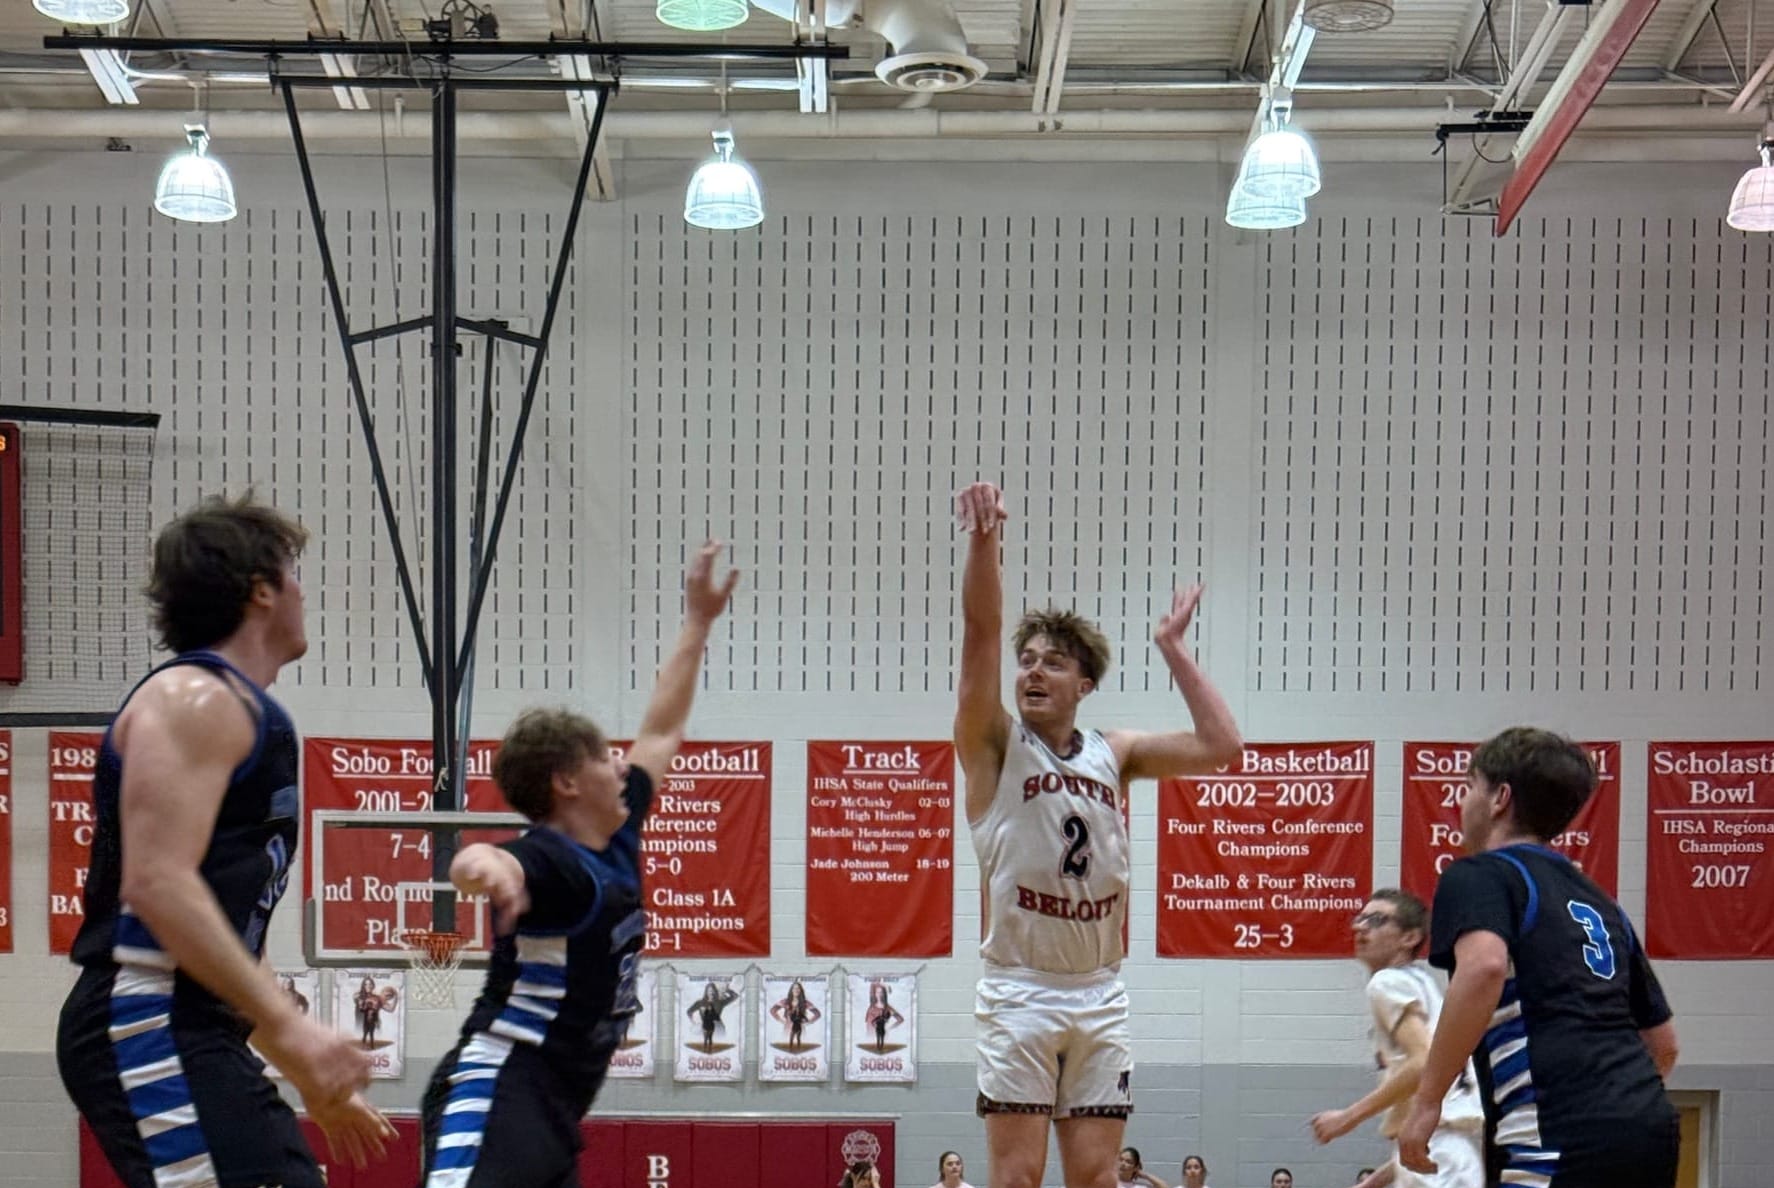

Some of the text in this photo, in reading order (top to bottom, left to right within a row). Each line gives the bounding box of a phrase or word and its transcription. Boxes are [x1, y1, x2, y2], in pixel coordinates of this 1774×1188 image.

[51, 748, 97, 768] 198
[331, 747, 391, 774] Sobo
[670, 748, 760, 772] ootball
[841, 745, 920, 769] Track
[1240, 748, 1370, 773] Basketball
[1654, 751, 1774, 775] Scholasti
[814, 777, 949, 793] IHSA State Qualifiers
[1023, 772, 1117, 810] SOUTH
[1688, 780, 1755, 804] Bowl
[659, 795, 722, 813] Rivers
[810, 796, 837, 809] Cory
[642, 814, 717, 832] ference
[845, 809, 916, 822] High Hurdles
[810, 826, 854, 838] Michelle
[858, 827, 914, 839] Henderson
[1167, 818, 1364, 835] Four Rivers Conference
[1663, 819, 1774, 837] IHSA Regiona
[390, 833, 431, 860] 7-4
[639, 835, 718, 856] ampions
[852, 840, 909, 853] High Jump
[1059, 811, 1092, 881] 2
[1217, 841, 1310, 860] Champions
[1678, 838, 1765, 856] Champions
[810, 858, 838, 869] Jade
[840, 858, 889, 869] Johnson
[850, 871, 909, 882] 200 Meter
[1172, 873, 1356, 890] Dekalb & Four Rivers
[1691, 865, 1751, 888] 2007
[653, 888, 737, 906] Class 1A
[1016, 885, 1119, 922] BELOIT
[1164, 894, 1363, 913] Tournament Champions
[1233, 923, 1294, 948] 25-3
[1567, 900, 1615, 980] 3
